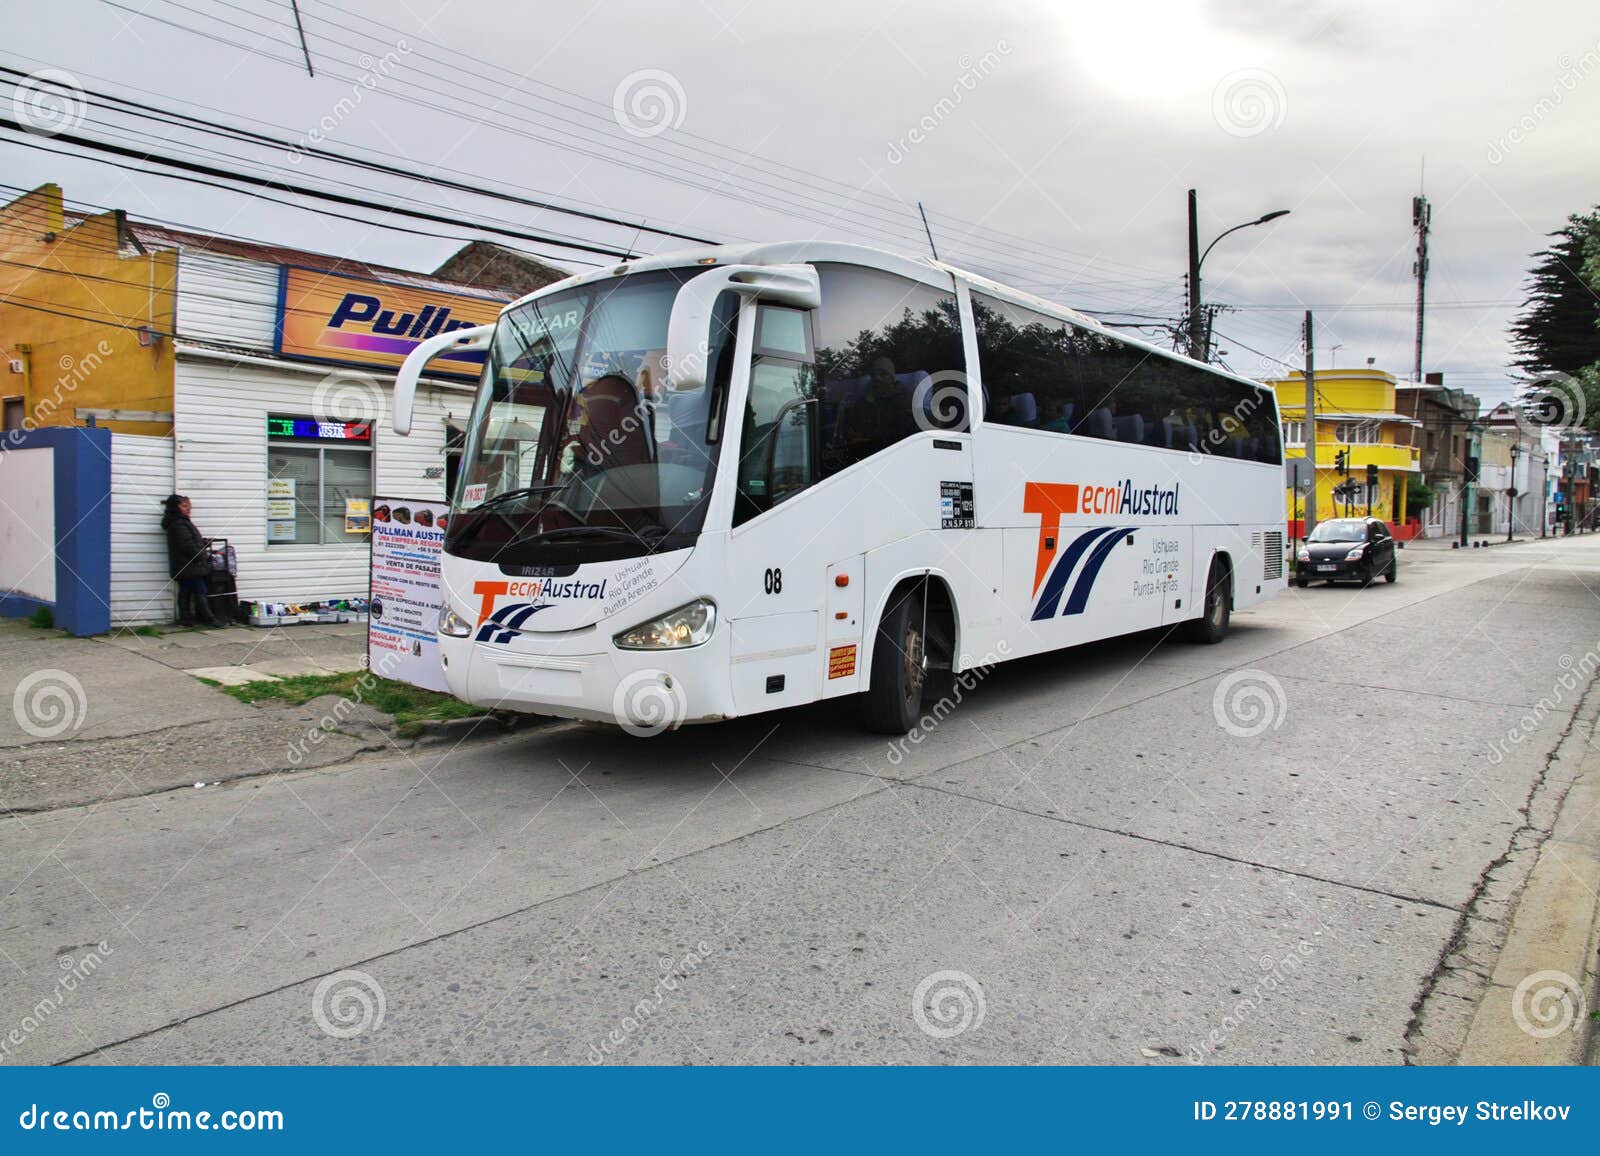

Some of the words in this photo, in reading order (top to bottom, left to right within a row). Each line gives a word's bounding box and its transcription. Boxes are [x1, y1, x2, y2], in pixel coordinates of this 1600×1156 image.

[373, 525, 413, 538] PULLMAN
[1023, 479, 1179, 602] TecniAustral
[1152, 536, 1179, 554] Ushuaia
[385, 560, 404, 568] VENTA
[614, 557, 649, 582] Ushuaia
[622, 567, 653, 591] Grande
[764, 567, 782, 595] 08
[473, 578, 607, 630] TecniAustral
[603, 597, 628, 616] Punta
[627, 578, 658, 602] Arenas
